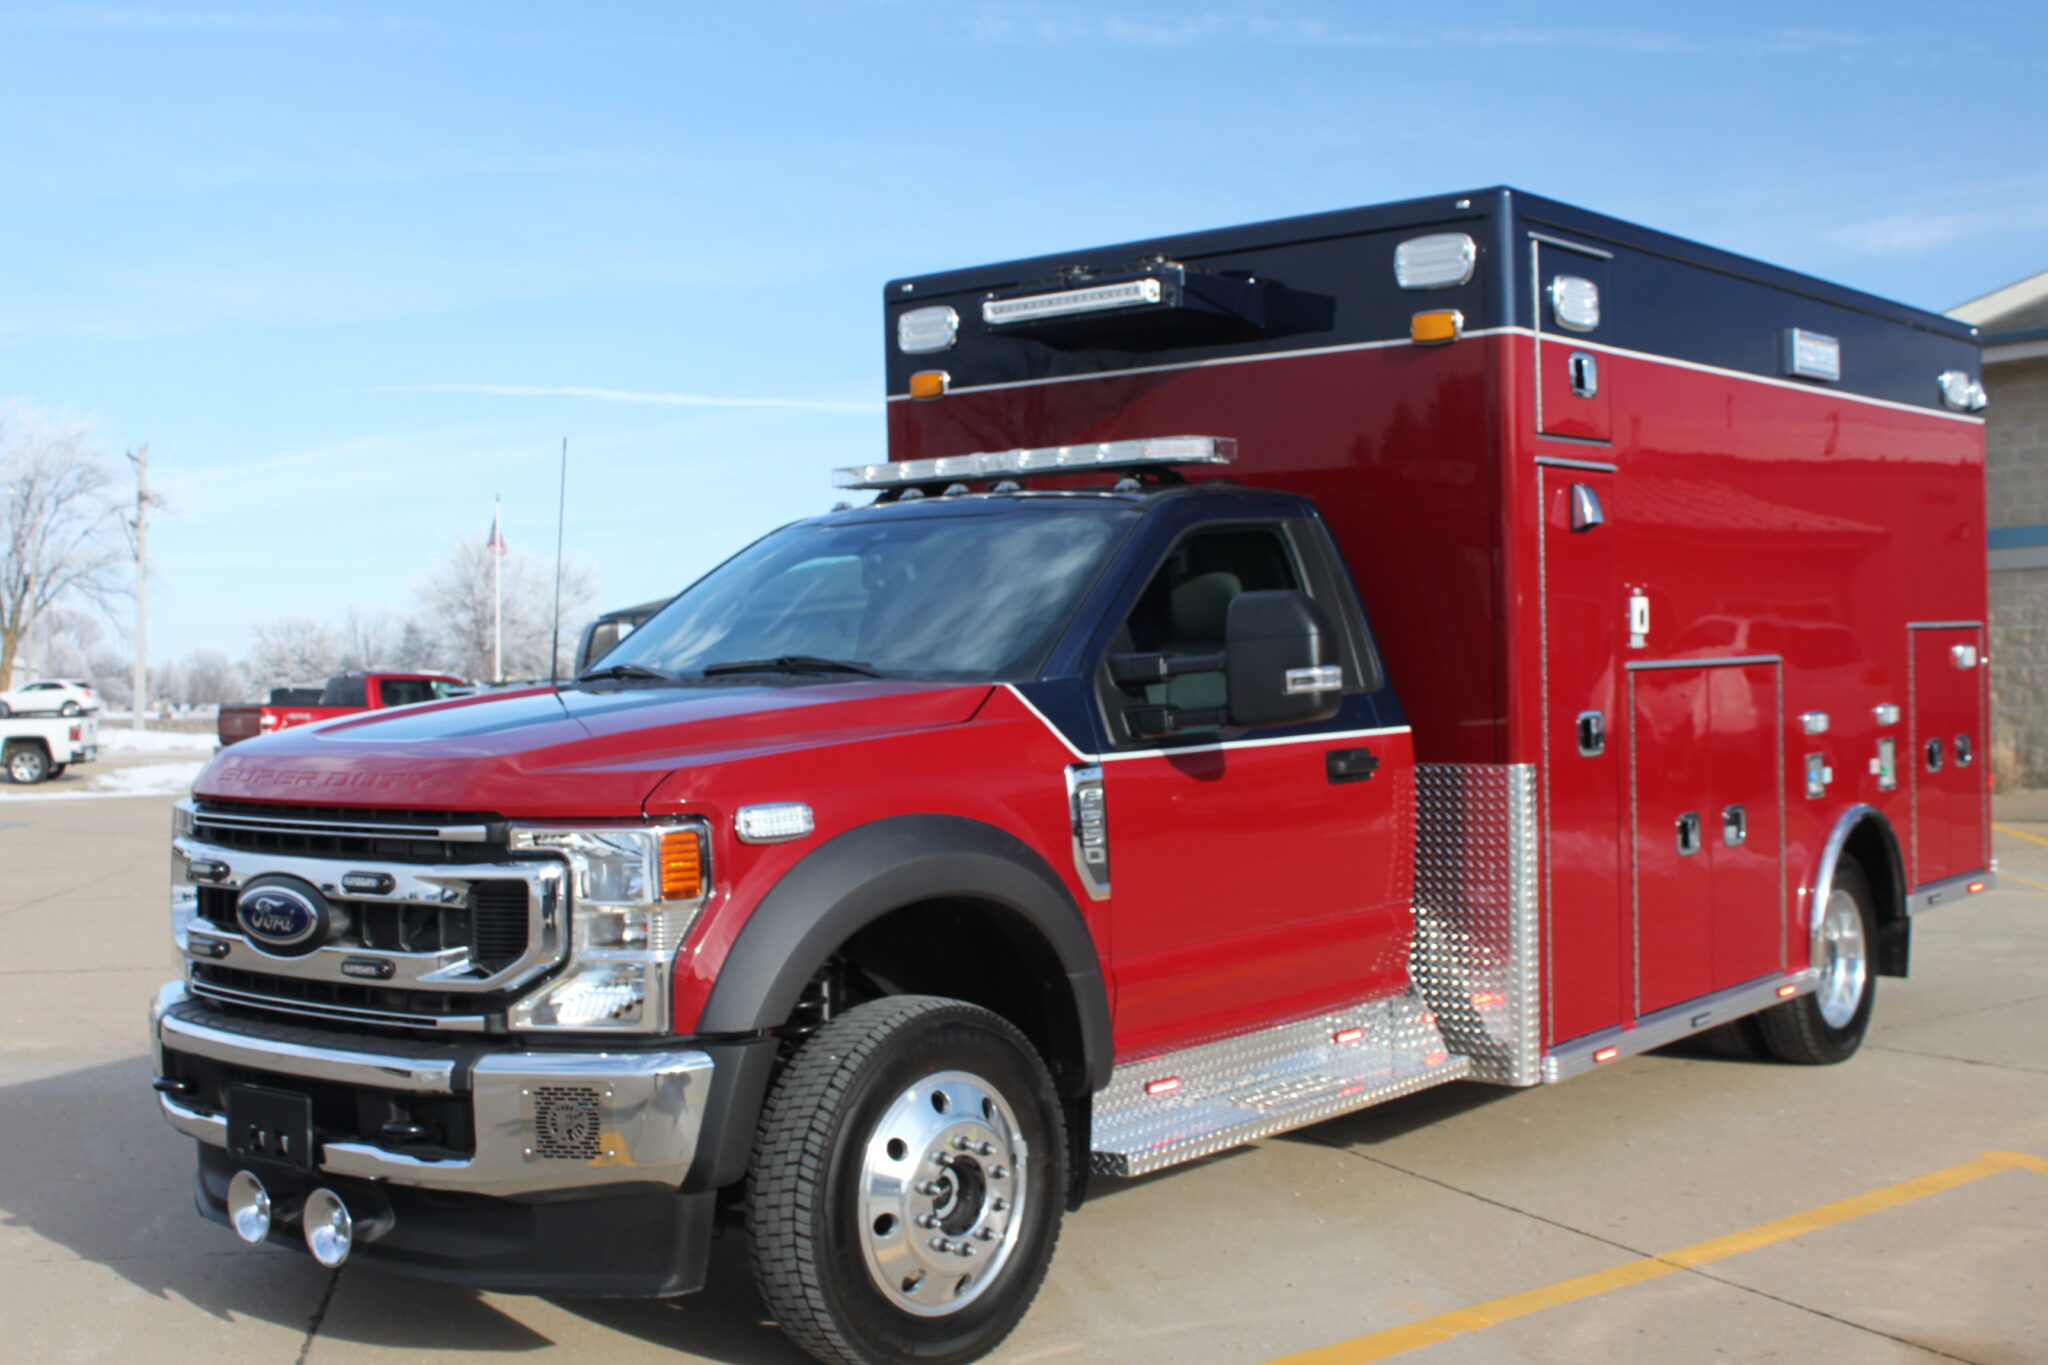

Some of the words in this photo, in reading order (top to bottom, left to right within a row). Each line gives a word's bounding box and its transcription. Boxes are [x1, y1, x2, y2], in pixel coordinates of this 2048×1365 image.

[217, 767, 321, 785] SUPER
[322, 770, 434, 789] DUTY
[251, 896, 296, 931] Ford
